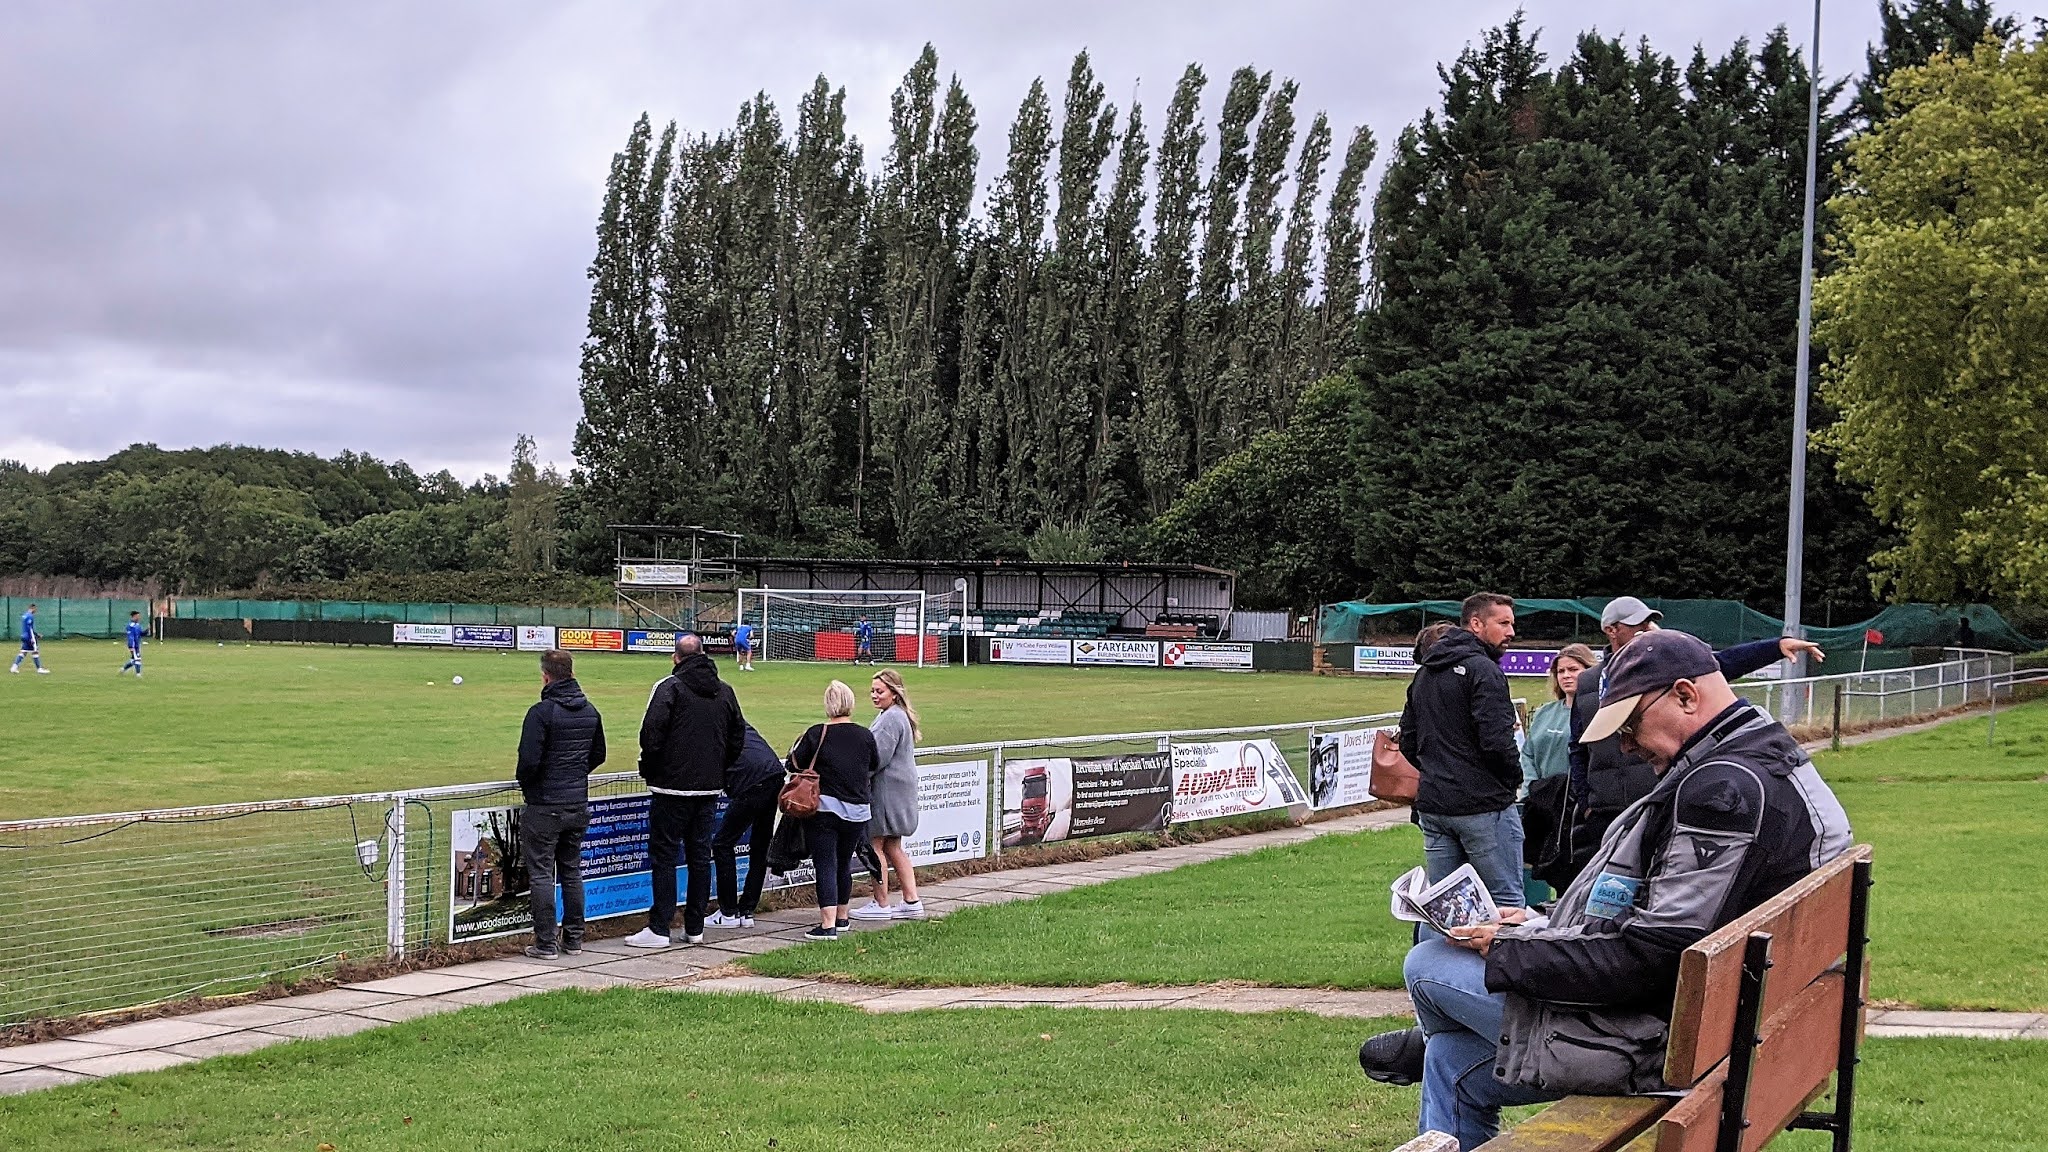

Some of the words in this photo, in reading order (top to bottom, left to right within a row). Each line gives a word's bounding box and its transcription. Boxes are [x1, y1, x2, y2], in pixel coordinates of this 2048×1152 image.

[414, 626, 447, 635] Heineken
[561, 630, 592, 640] GOODY
[646, 632, 676, 640] GORDON
[702, 635, 729, 645] Martin
[1097, 642, 1156, 652] FARYEARNY
[1378, 650, 1414, 658] BLINDS
[1141, 757, 1157, 770] Truck
[948, 771, 961, 781] prices
[924, 783, 932, 791] but
[936, 783, 944, 792] you
[944, 781, 953, 789] find
[960, 780, 971, 788] same
[971, 778, 980, 786] deal
[1100, 779, 1109, 787] Parts
[1111, 778, 1123, 787] Service
[947, 789, 972, 799] Commercial
[1174, 793, 1197, 806] radio
[595, 803, 609, 812] family
[610, 801, 628, 810] function
[948, 800, 962, 808] match
[967, 798, 977, 806] beat
[1171, 811, 1191, 821] Sales
[1196, 806, 1214, 818] Hire
[1220, 803, 1247, 815] Service
[602, 814, 621, 824] function
[621, 813, 637, 821] rooms
[615, 820, 642, 832] Wedding
[591, 838, 609, 847] service
[609, 836, 632, 846] available
[632, 833, 641, 841] and
[615, 842, 634, 853] which
[590, 856, 607, 867] Lunch
[611, 854, 633, 866] Saturday
[633, 851, 649, 862] Nights
[601, 864, 608, 874] on
[586, 887, 600, 896] not
[608, 882, 640, 893] members
[586, 901, 604, 914] open
[605, 900, 614, 909] to
[615, 898, 628, 908] the
